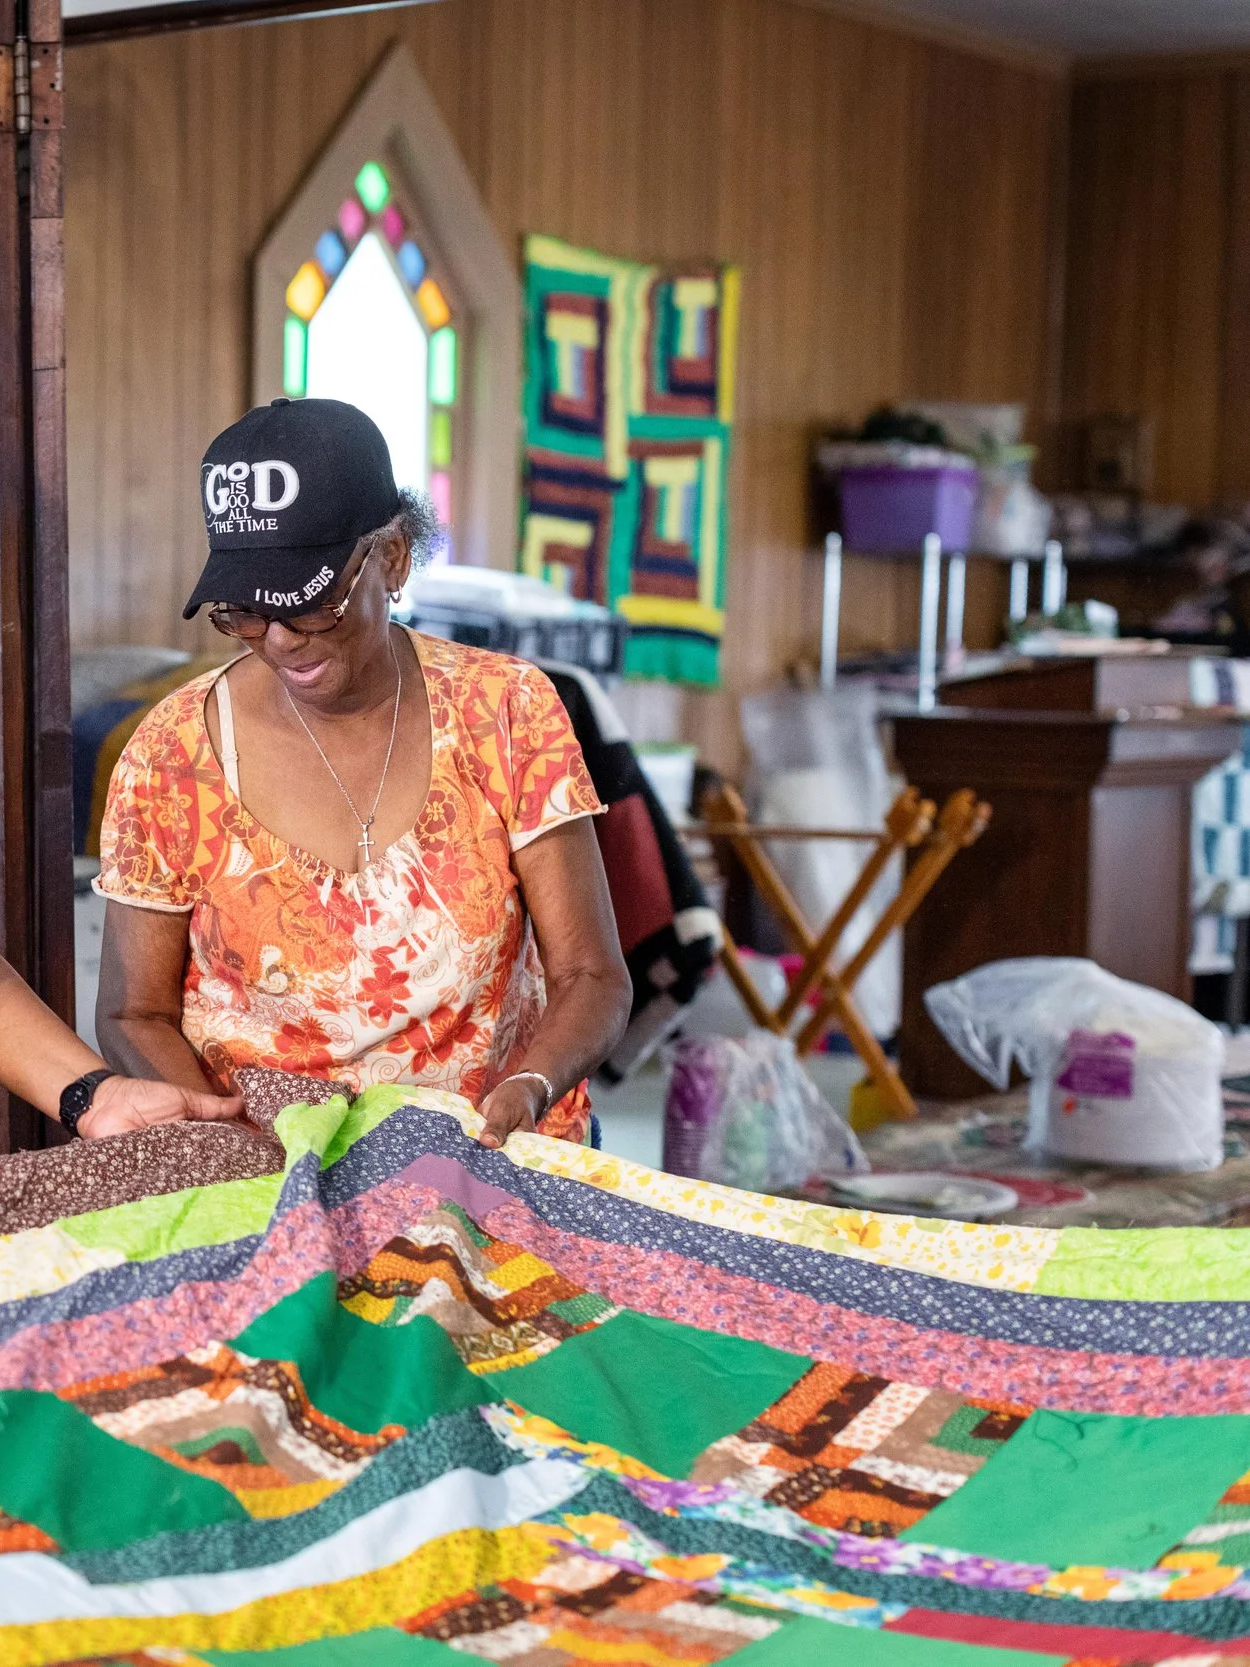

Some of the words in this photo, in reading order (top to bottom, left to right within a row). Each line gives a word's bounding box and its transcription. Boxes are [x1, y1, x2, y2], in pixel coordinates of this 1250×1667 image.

[230, 482, 247, 494] IS
[228, 508, 252, 520] ALL
[214, 521, 234, 534] THE
[236, 519, 278, 532] TIME
[255, 588, 261, 602] I
[264, 590, 303, 607] LOVE
[302, 565, 335, 601] JESUS
